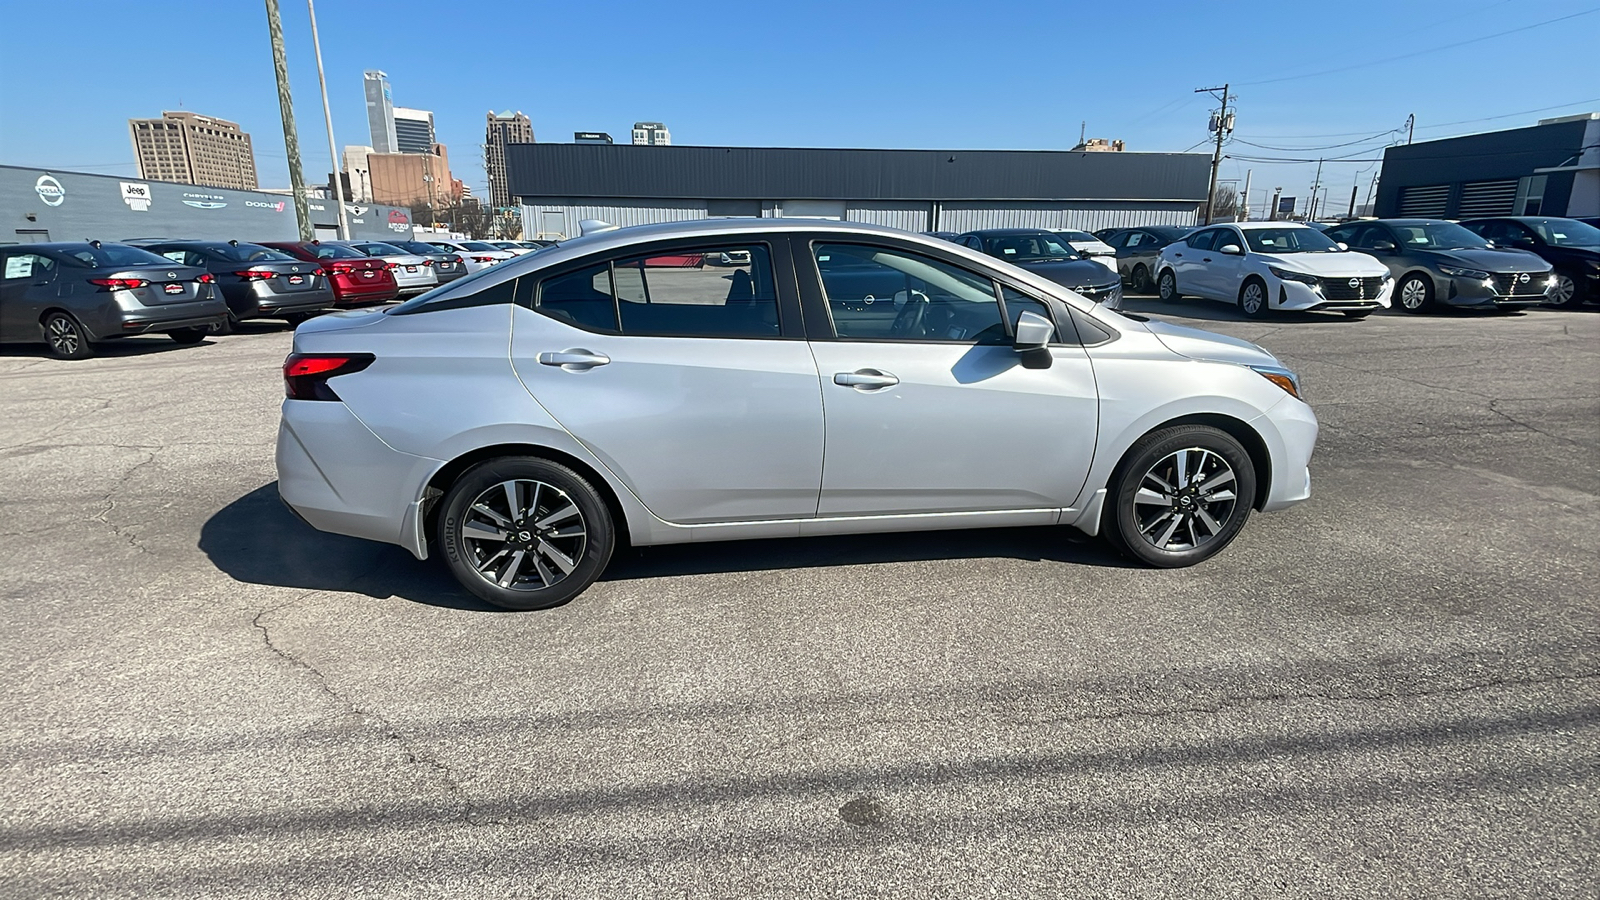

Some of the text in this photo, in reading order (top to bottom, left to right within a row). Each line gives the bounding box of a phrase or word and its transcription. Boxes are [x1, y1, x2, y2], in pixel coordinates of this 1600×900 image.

[38, 187, 63, 195] NISSAN
[126, 184, 146, 196] Jeep
[445, 516, 460, 563] KUMHO
